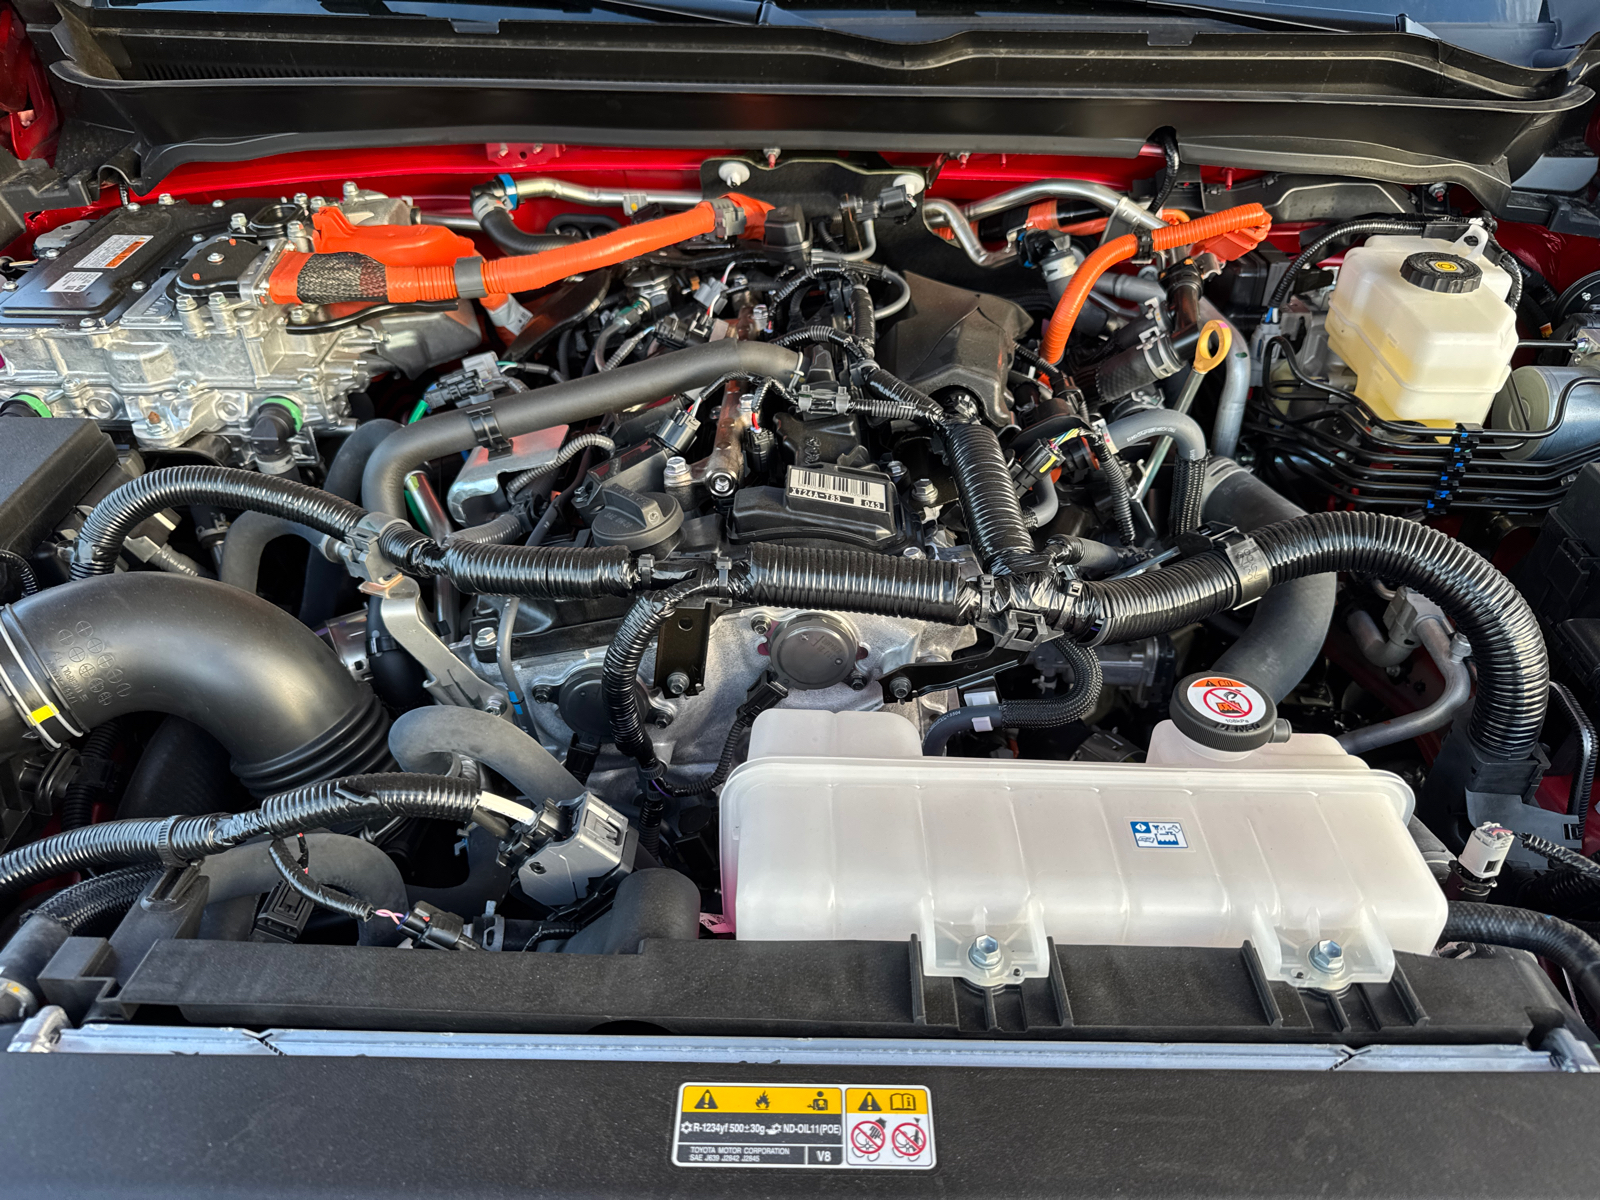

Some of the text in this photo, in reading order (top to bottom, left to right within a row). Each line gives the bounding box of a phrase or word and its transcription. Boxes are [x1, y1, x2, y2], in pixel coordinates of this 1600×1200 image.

[864, 500, 881, 509] 043
[693, 1123, 842, 1136] R-1234yf 500±30g ND-OIL11(POE)
[744, 1147, 790, 1155] CORPORATION
[816, 1151, 832, 1162] V8
